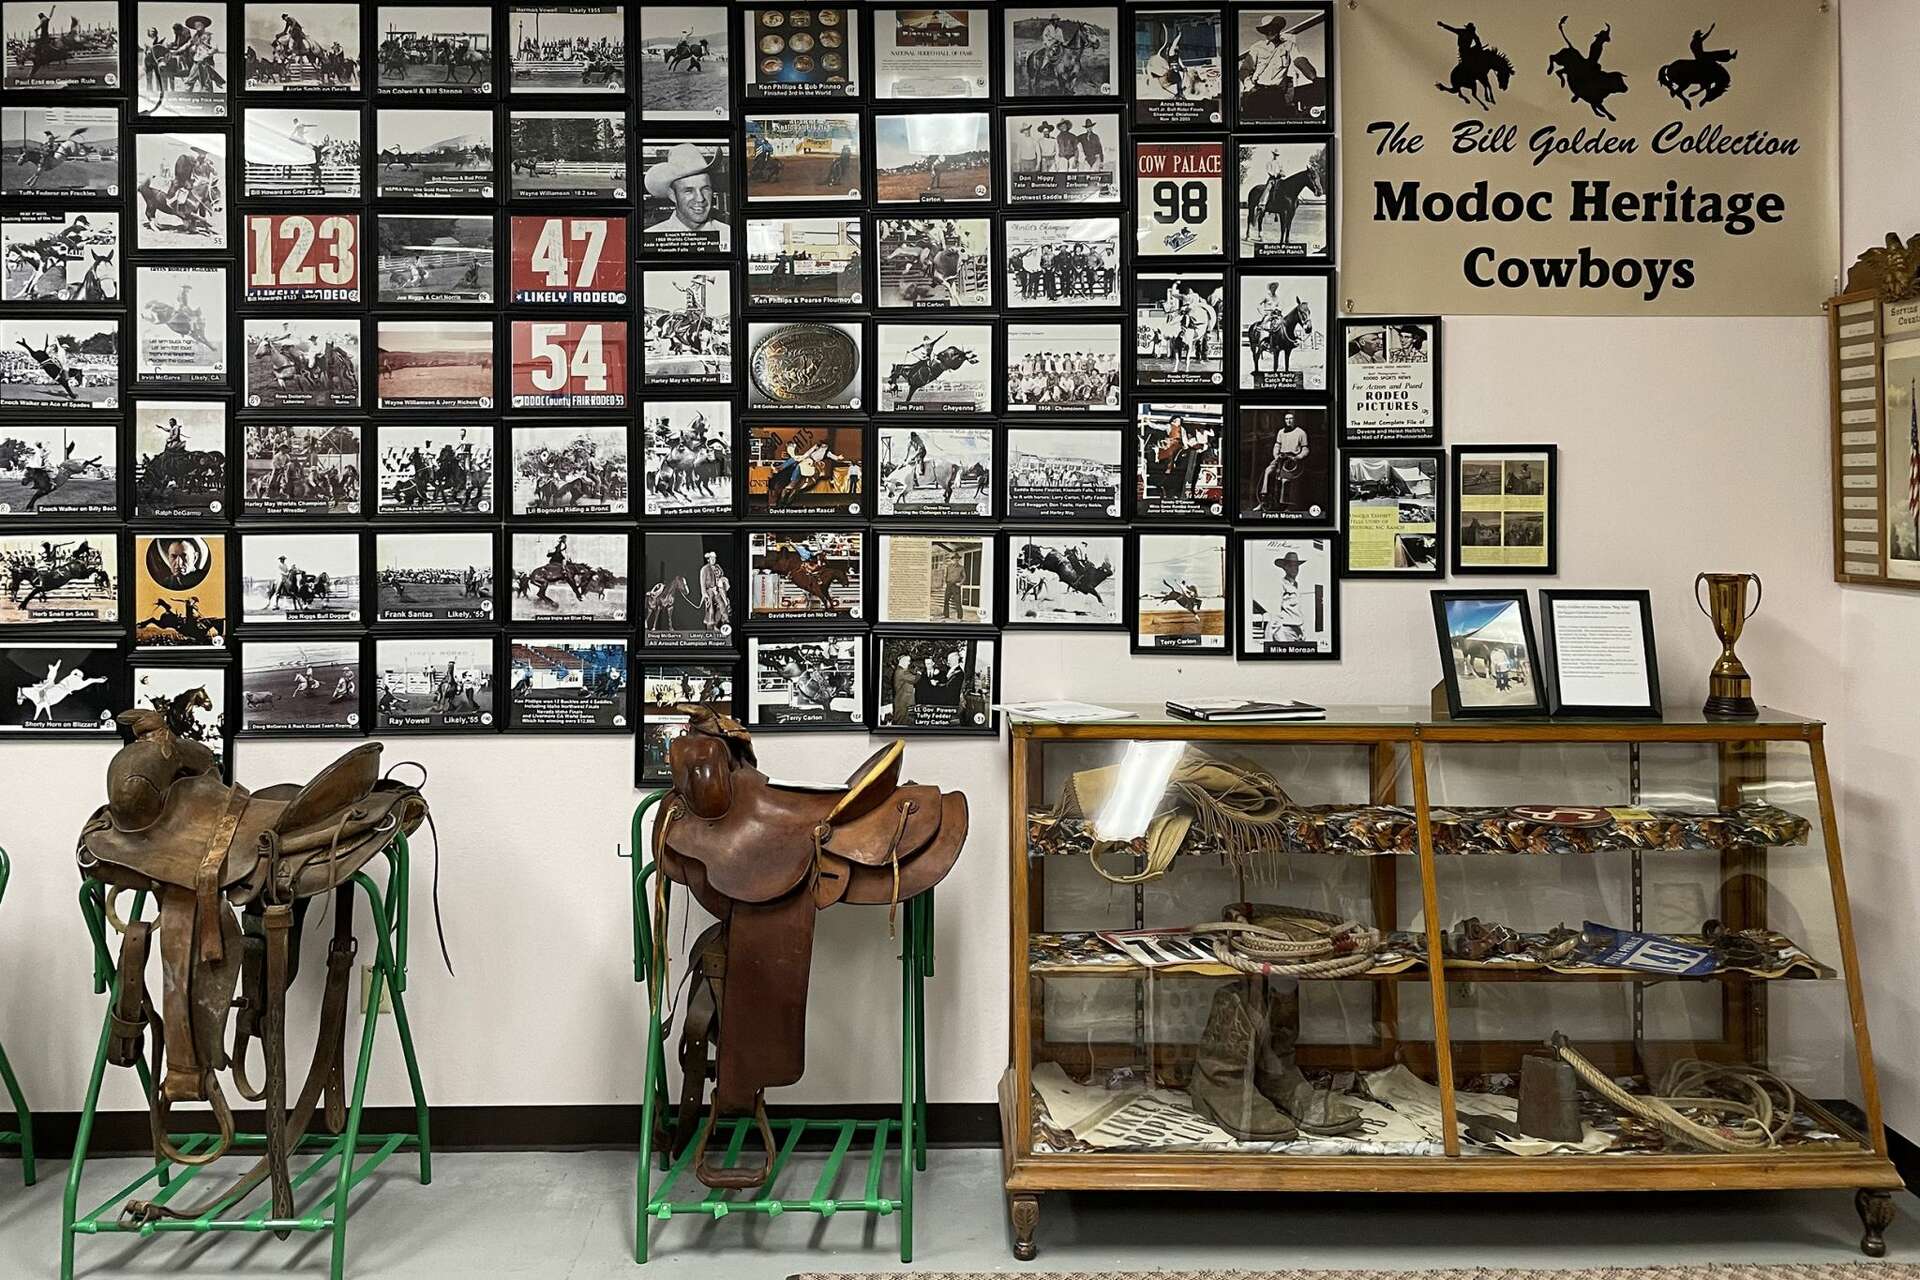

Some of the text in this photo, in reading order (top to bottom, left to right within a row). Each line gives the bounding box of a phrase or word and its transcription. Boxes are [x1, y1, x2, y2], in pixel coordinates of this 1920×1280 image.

[1366, 120, 1800, 166] The Bill Golden Collection
[1139, 155, 1222, 173] COW PALACE
[1153, 181, 1207, 224] 98
[1373, 181, 1785, 236] Modoc Heritage
[250, 216, 355, 287] 123
[531, 218, 608, 287] 47
[1463, 246, 1695, 301] Cowboys
[524, 292, 618, 303] LIKELY RODEO
[531, 324, 607, 391] 54
[546, 395, 570, 407] County
[1357, 401, 1419, 411] PICTURES
[1366, 391, 1408, 400] RODEO
[447, 611, 472, 619] Likely,
[389, 717, 403, 726] Ray
[444, 716, 468, 725] Likely,
